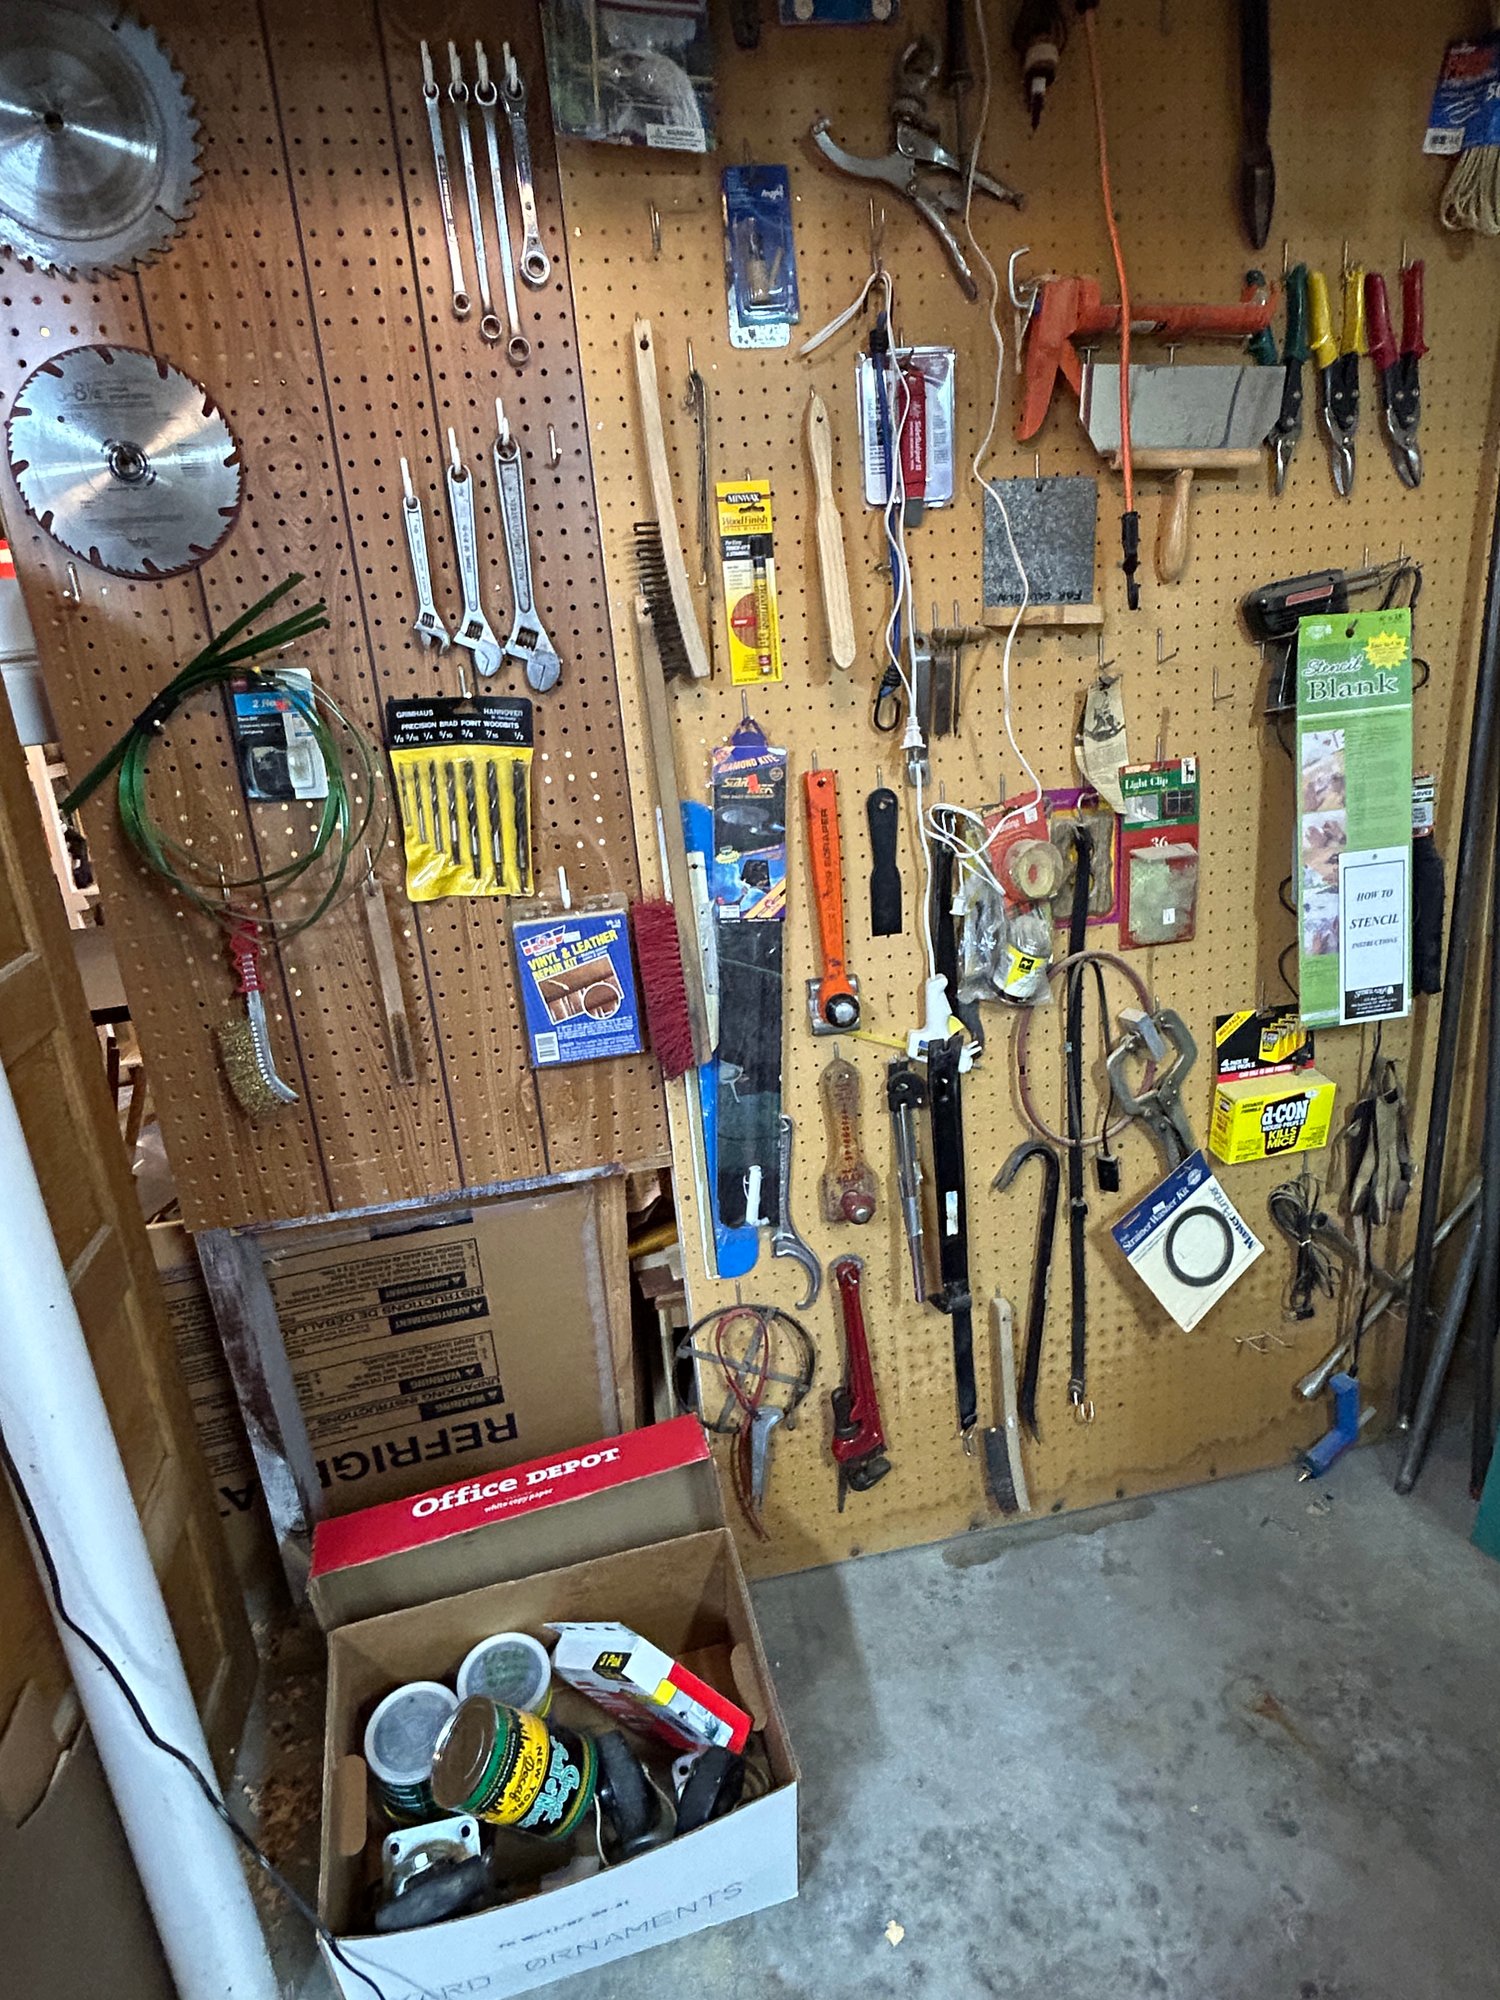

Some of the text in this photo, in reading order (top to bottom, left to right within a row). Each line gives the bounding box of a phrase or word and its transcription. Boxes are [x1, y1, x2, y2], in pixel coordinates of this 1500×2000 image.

[727, 493, 760, 503] MINWAX
[1303, 654, 1364, 676] Stencil
[1306, 672, 1399, 702] Blank
[401, 722, 437, 731] PRECISION
[1125, 776, 1168, 790] Light Clip
[1412, 789, 1433, 797] LOVES
[1151, 836, 1168, 847] 36
[1357, 889, 1394, 902] HOW TO
[1350, 914, 1400, 930] STENCIL
[527, 951, 561, 971] VINYL
[561, 947, 571, 959] &
[571, 929, 619, 955] LEATHER
[532, 957, 578, 981] REPAIR KIT
[1220, 1058, 1229, 1067] 4
[1261, 1099, 1310, 1126] d-CON
[1268, 1126, 1297, 1140] KILLS
[1266, 1135, 1296, 1149] MICE
[1122, 1220, 1152, 1252] Strainer
[1176, 1186, 1190, 1201] Kit
[381, 1287, 485, 1314] INSTRUCTIONS
[358, 1308, 379, 1321] DE
[409, 1369, 461, 1385] WARNING
[317, 1377, 500, 1426] UNPACKING INSTRUCTIONS
[434, 1394, 487, 1411] WARNING
[411, 1448, 620, 1518] Office DEPOT
[484, 1488, 554, 1513] white copy paper
[598, 1653, 623, 1668] 3 Pak
[508, 1755, 535, 1803] Decaf
[508, 1745, 543, 1815] NEW YORK
[403, 1976, 491, 2000] RD
